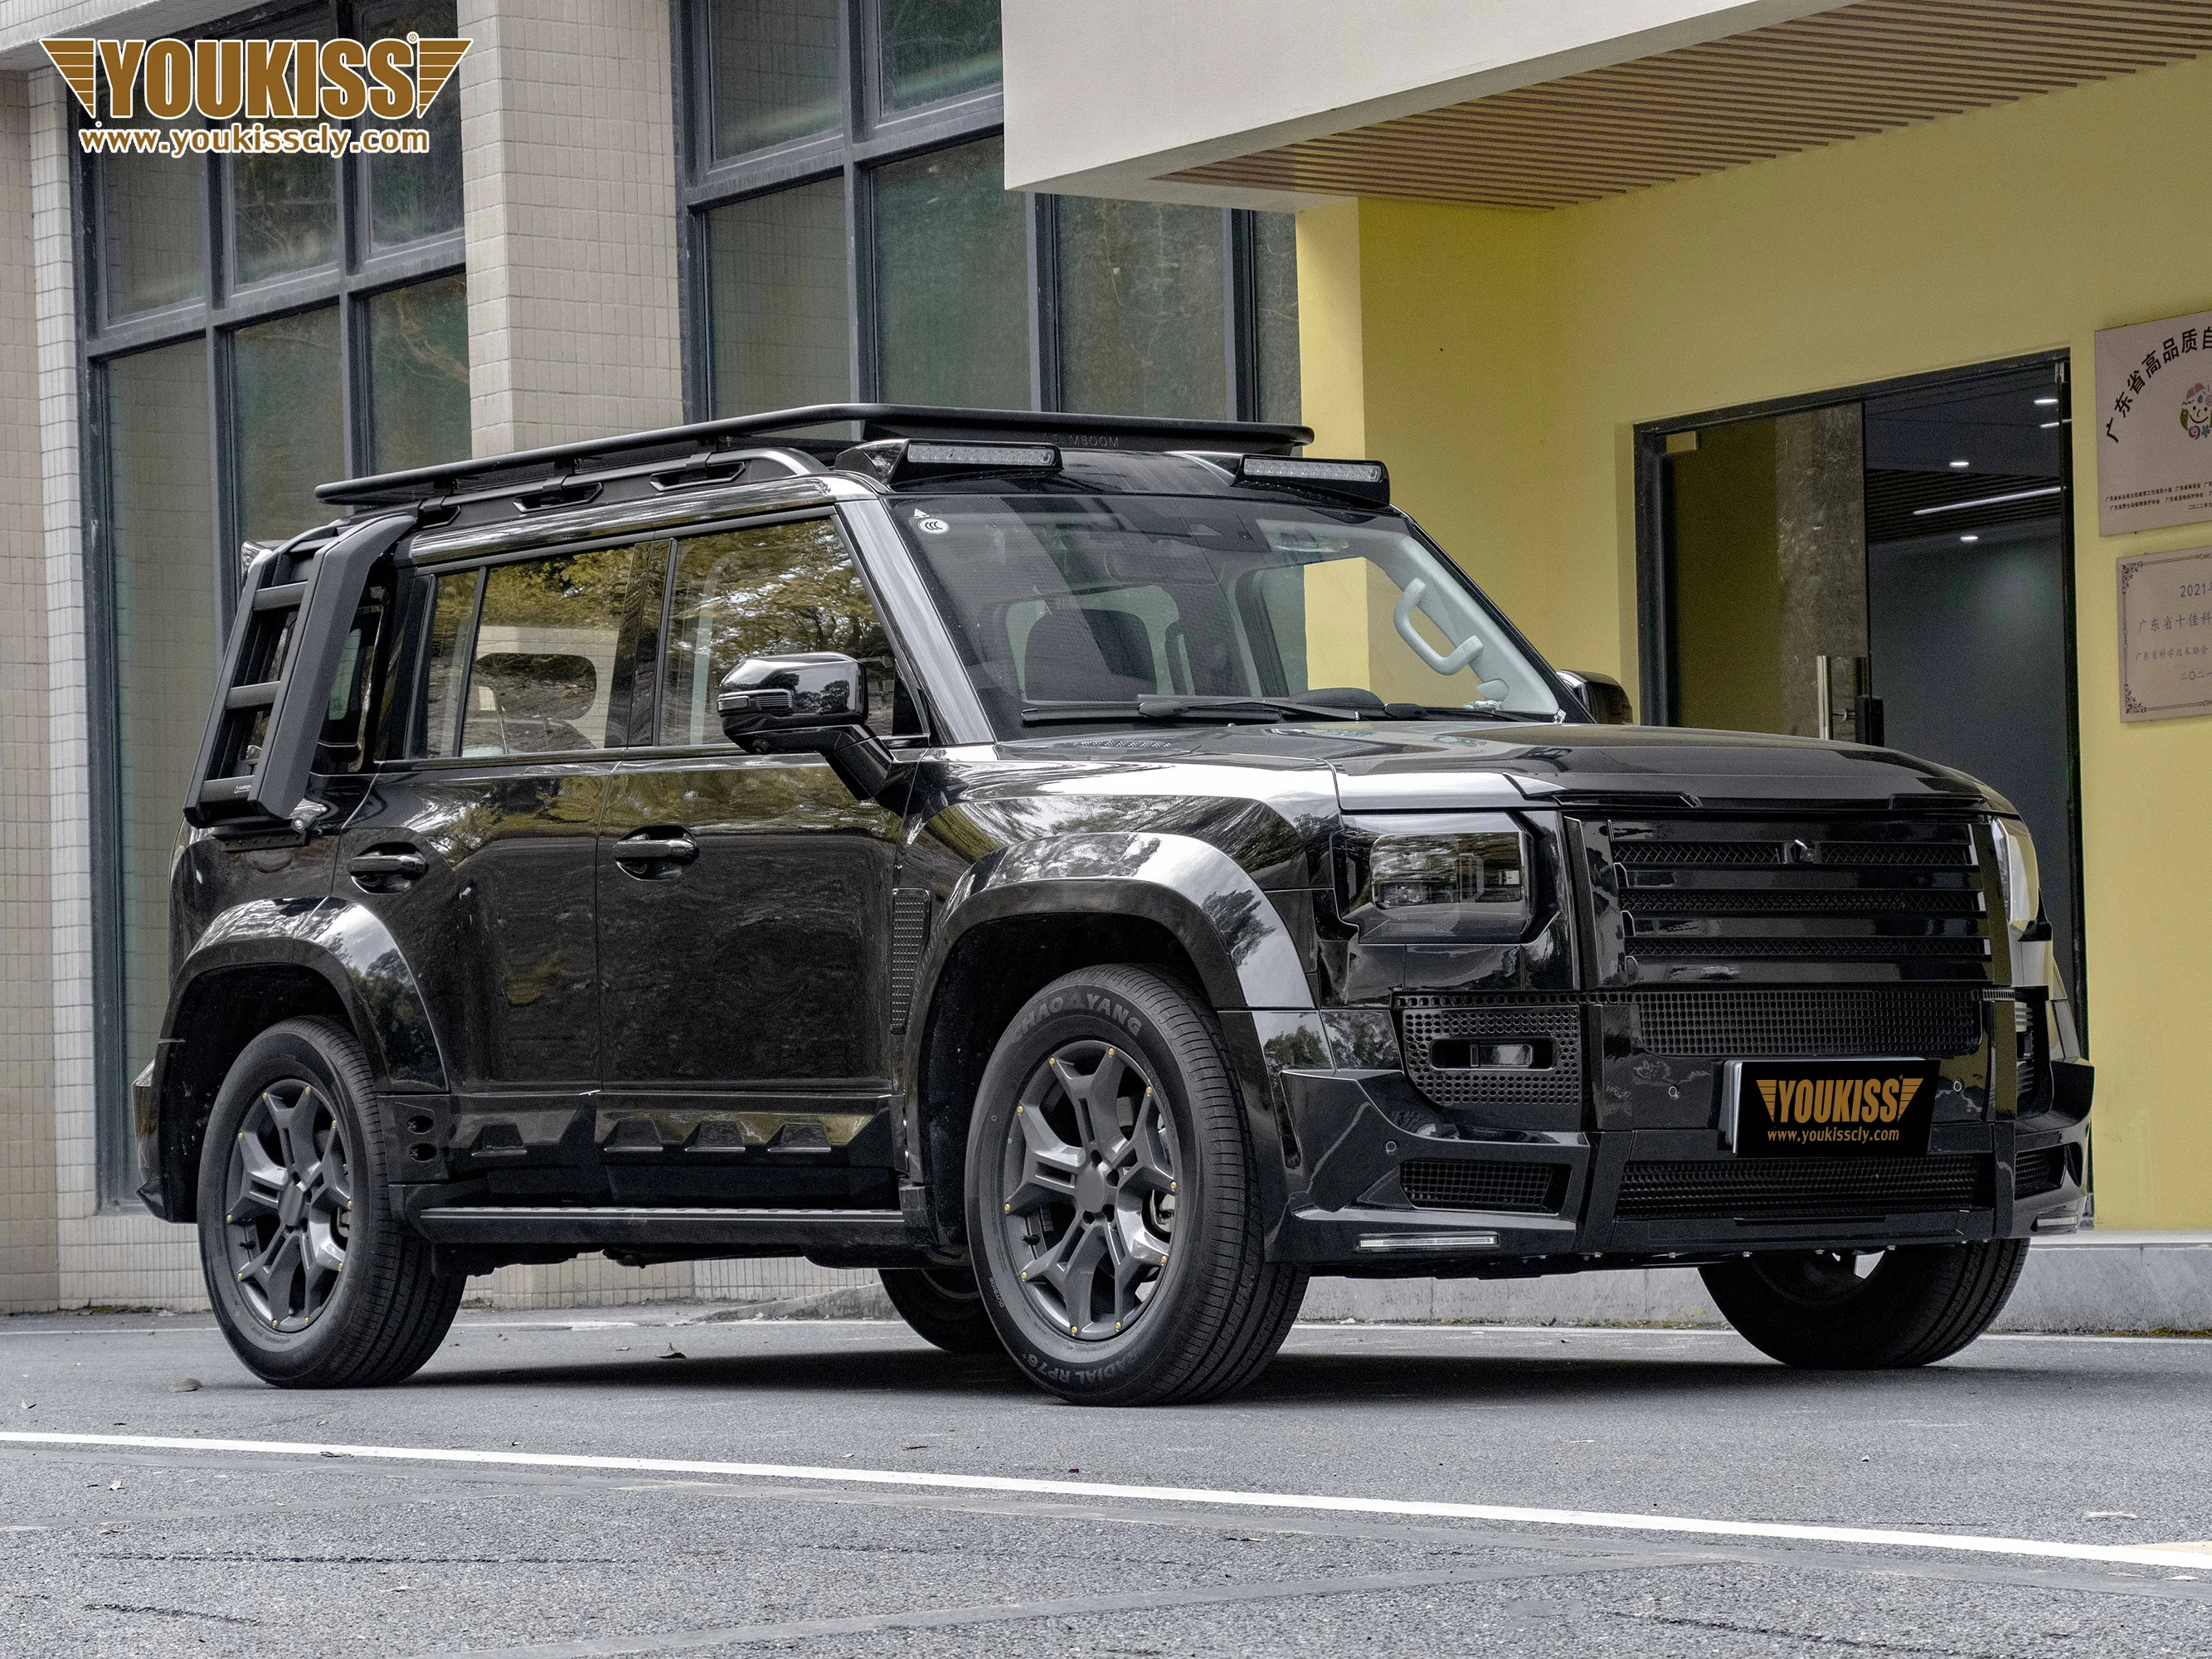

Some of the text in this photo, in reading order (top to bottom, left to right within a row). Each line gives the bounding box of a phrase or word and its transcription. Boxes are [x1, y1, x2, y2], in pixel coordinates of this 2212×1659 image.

[1011, 994, 1143, 1044] CHAO YANG
[1778, 1078, 1900, 1123] YOUKISS
[1767, 1126, 1899, 1145] www.youkisscly.com
